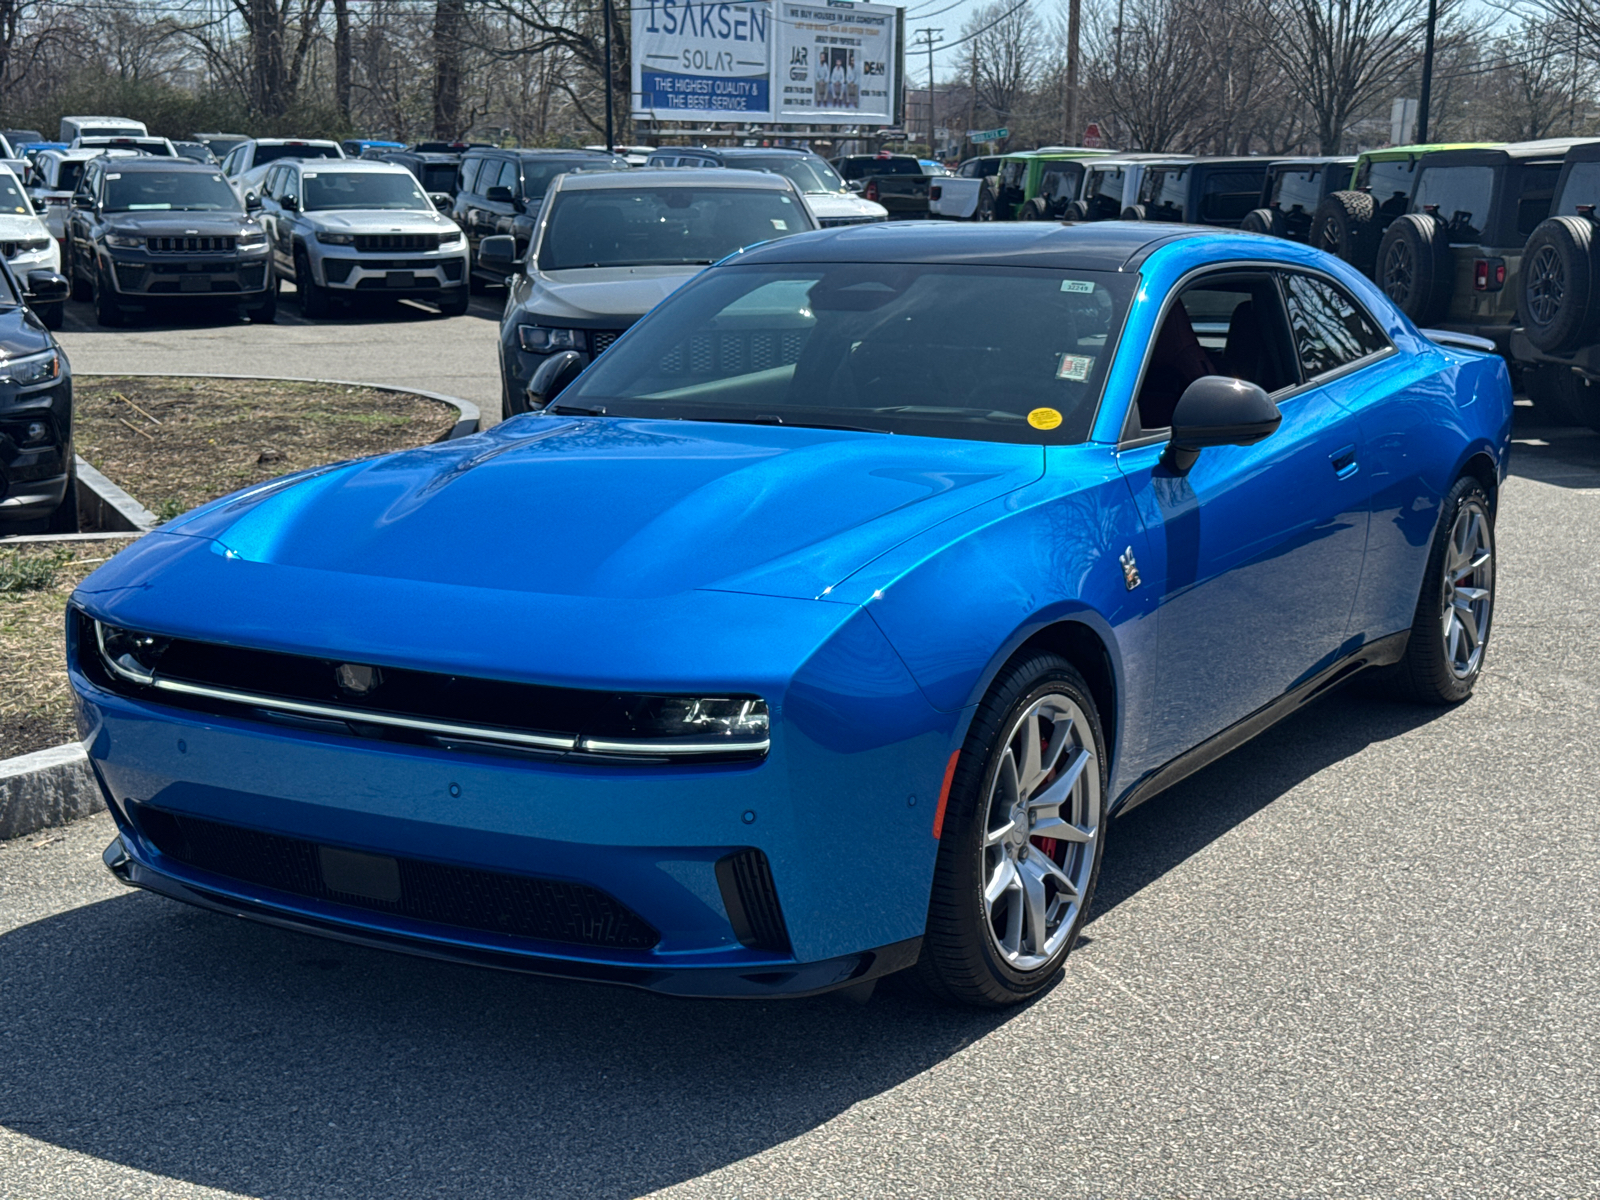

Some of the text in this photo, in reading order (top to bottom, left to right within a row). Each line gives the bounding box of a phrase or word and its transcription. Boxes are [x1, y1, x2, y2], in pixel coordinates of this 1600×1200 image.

[646, 0, 765, 43] ISAKSEN
[801, 9, 812, 18] BUY
[813, 11, 836, 20] HOUSES
[682, 49, 733, 72] SOLAR
[790, 46, 808, 65] JAR
[863, 61, 885, 76] DEAN
[654, 77, 758, 96] THE HIGHEST QUALITY &
[667, 94, 747, 110] THE BEST SERVICE
